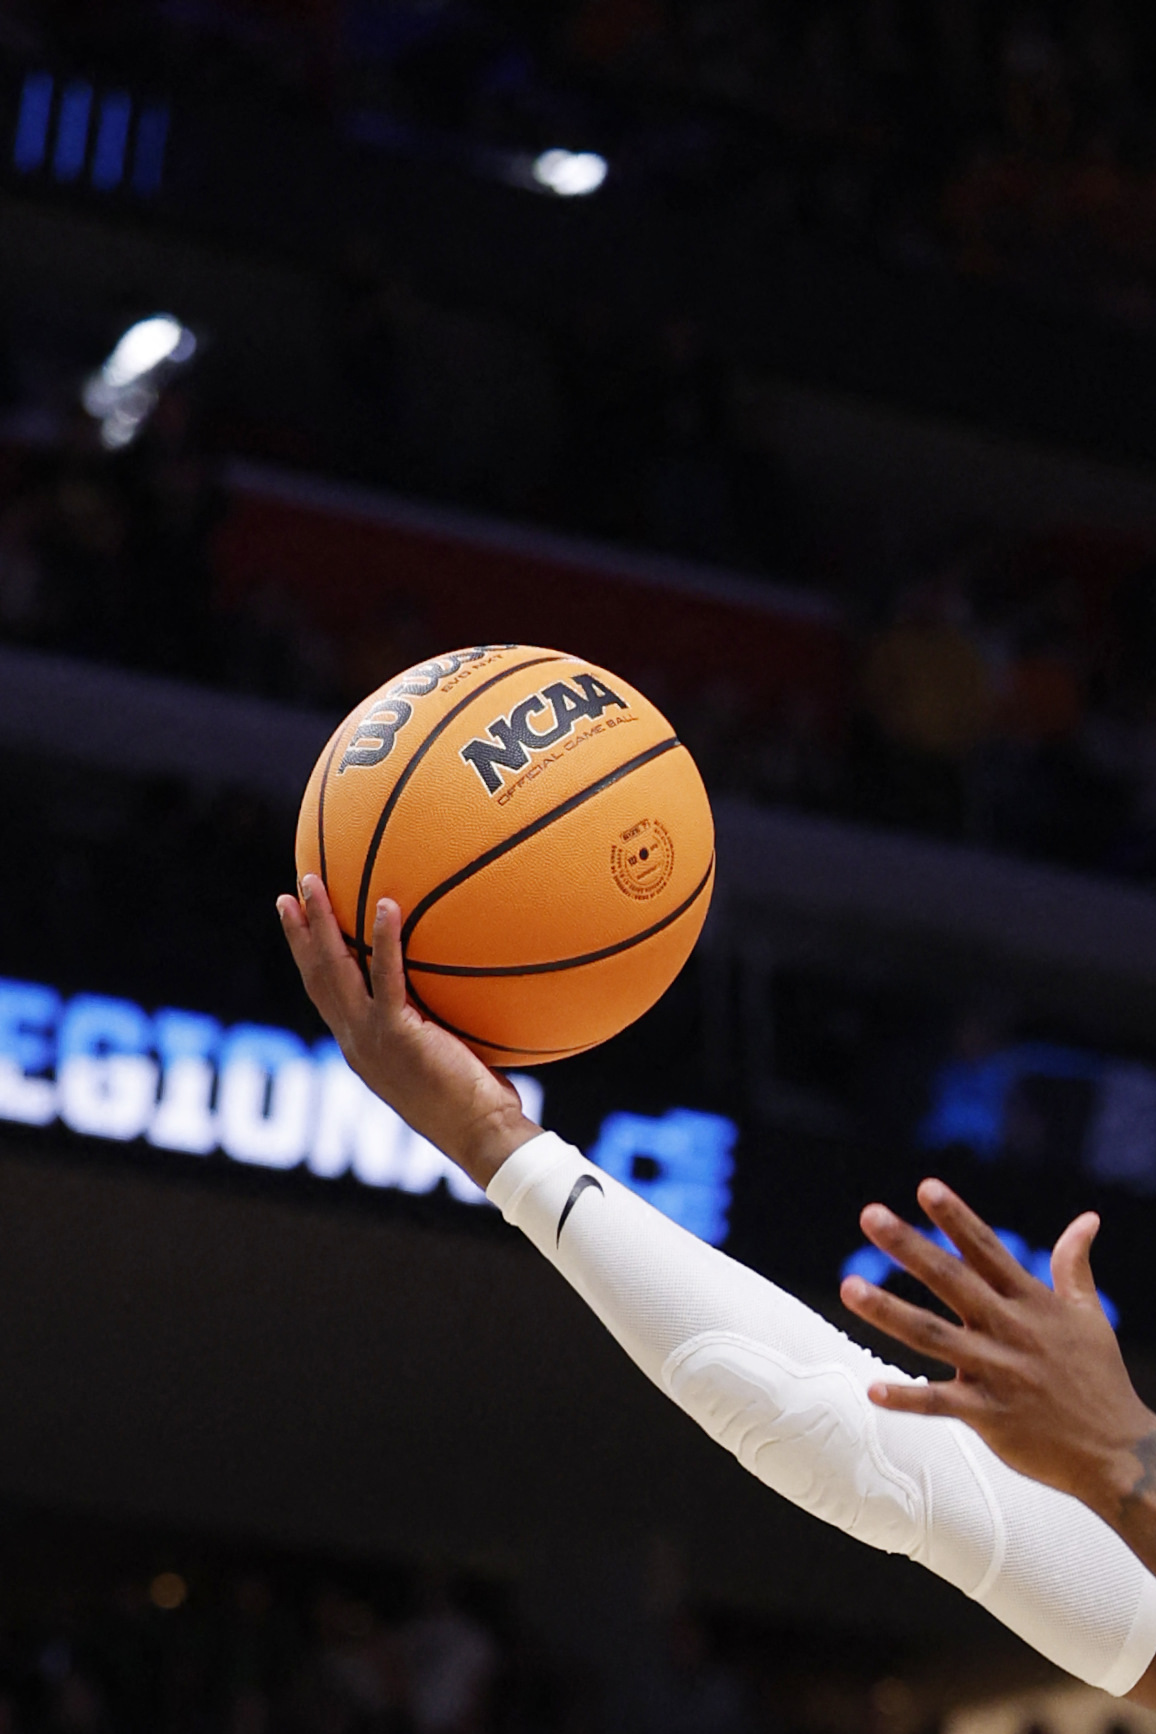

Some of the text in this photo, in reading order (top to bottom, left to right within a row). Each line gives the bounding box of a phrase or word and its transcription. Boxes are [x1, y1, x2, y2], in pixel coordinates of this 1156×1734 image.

[441, 671, 471, 693] EVO
[459, 673, 631, 795] NCAA
[497, 713, 639, 806] OFFICIAL GAME BALL
